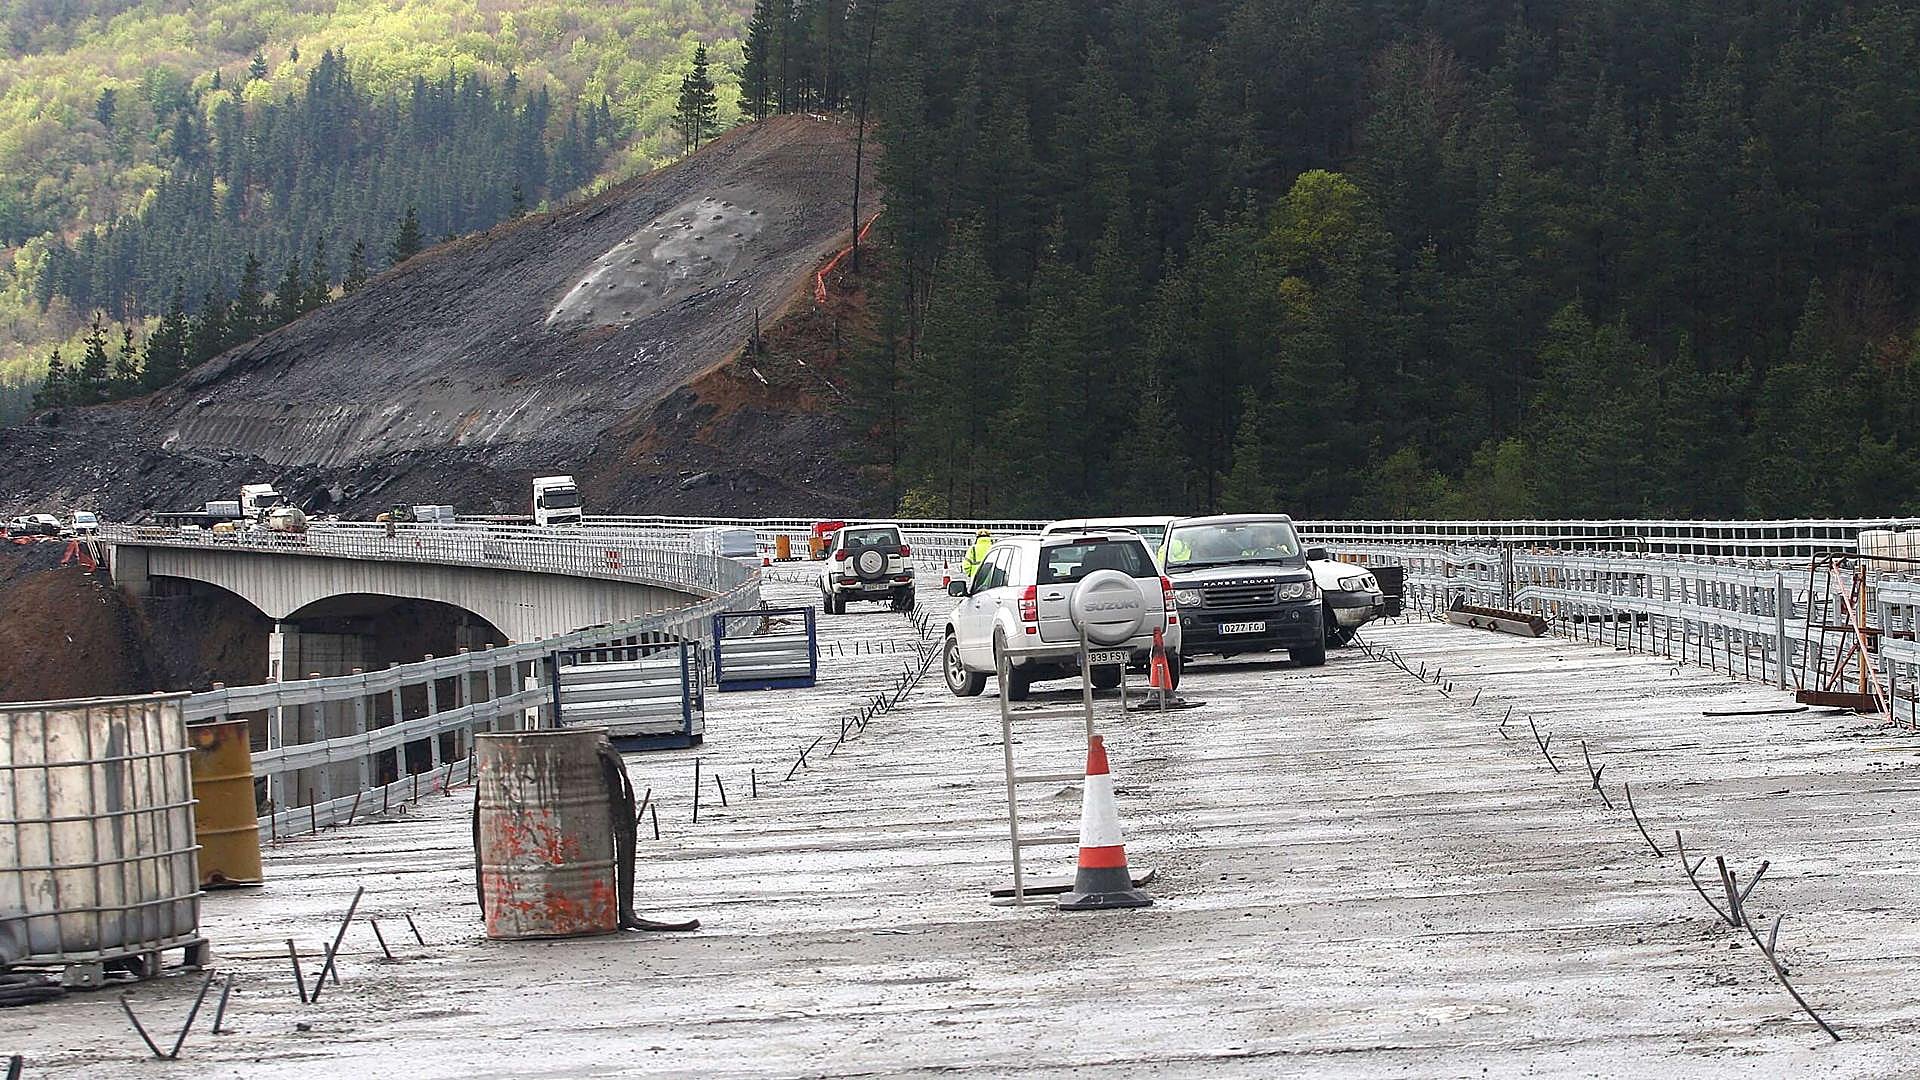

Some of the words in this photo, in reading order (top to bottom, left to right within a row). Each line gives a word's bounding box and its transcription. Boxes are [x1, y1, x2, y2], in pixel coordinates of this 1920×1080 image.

[1084, 600, 1139, 612] SUZUKI
[1224, 624, 1246, 632] 0277
[1110, 651, 1126, 661] FSY
